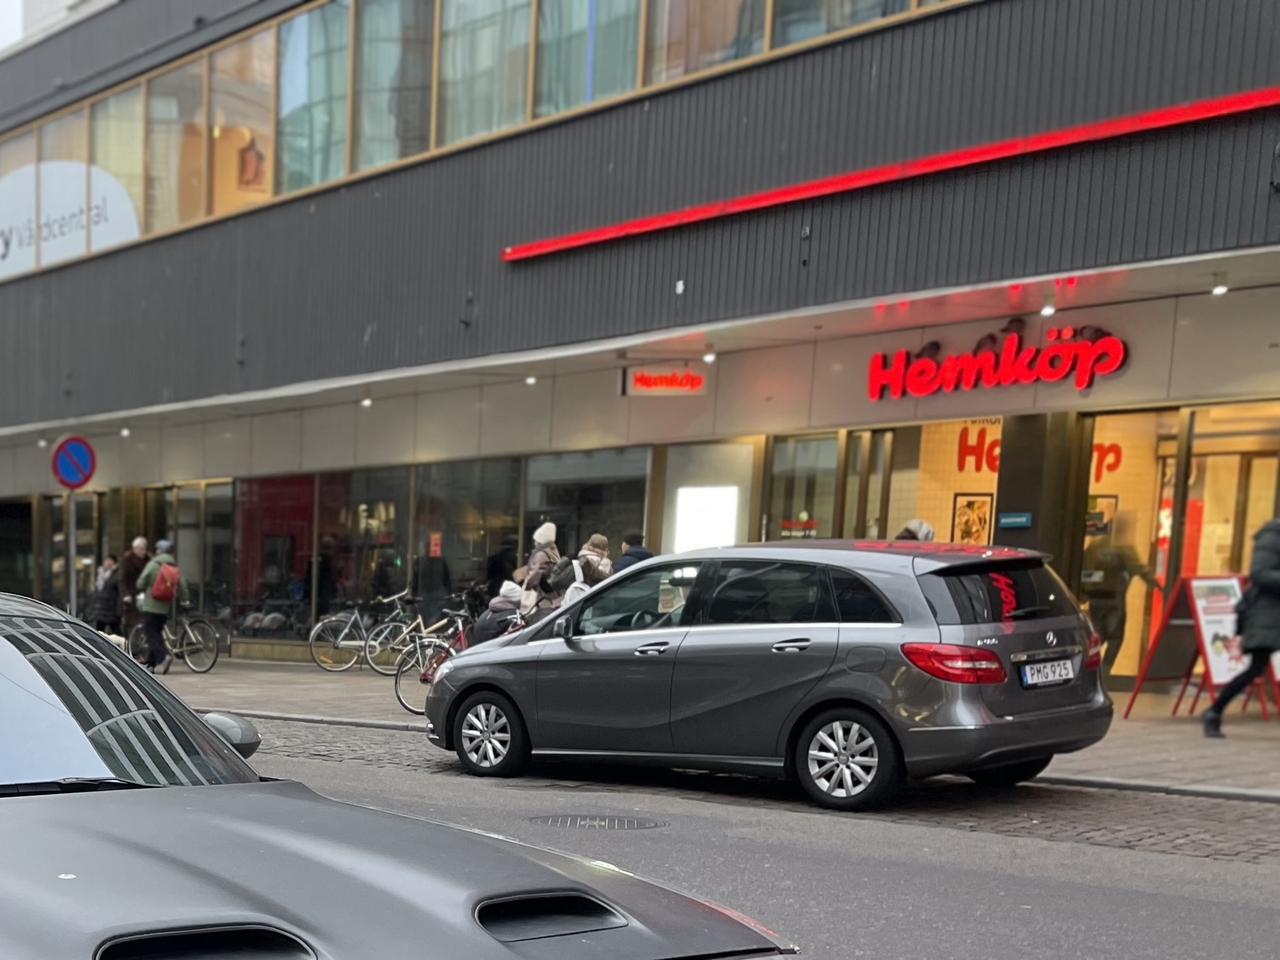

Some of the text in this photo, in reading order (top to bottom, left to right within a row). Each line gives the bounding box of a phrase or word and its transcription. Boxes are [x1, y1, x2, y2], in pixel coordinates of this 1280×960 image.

[868, 326, 1124, 402] Hemköp
[1030, 662, 1070, 681] PMG 925
